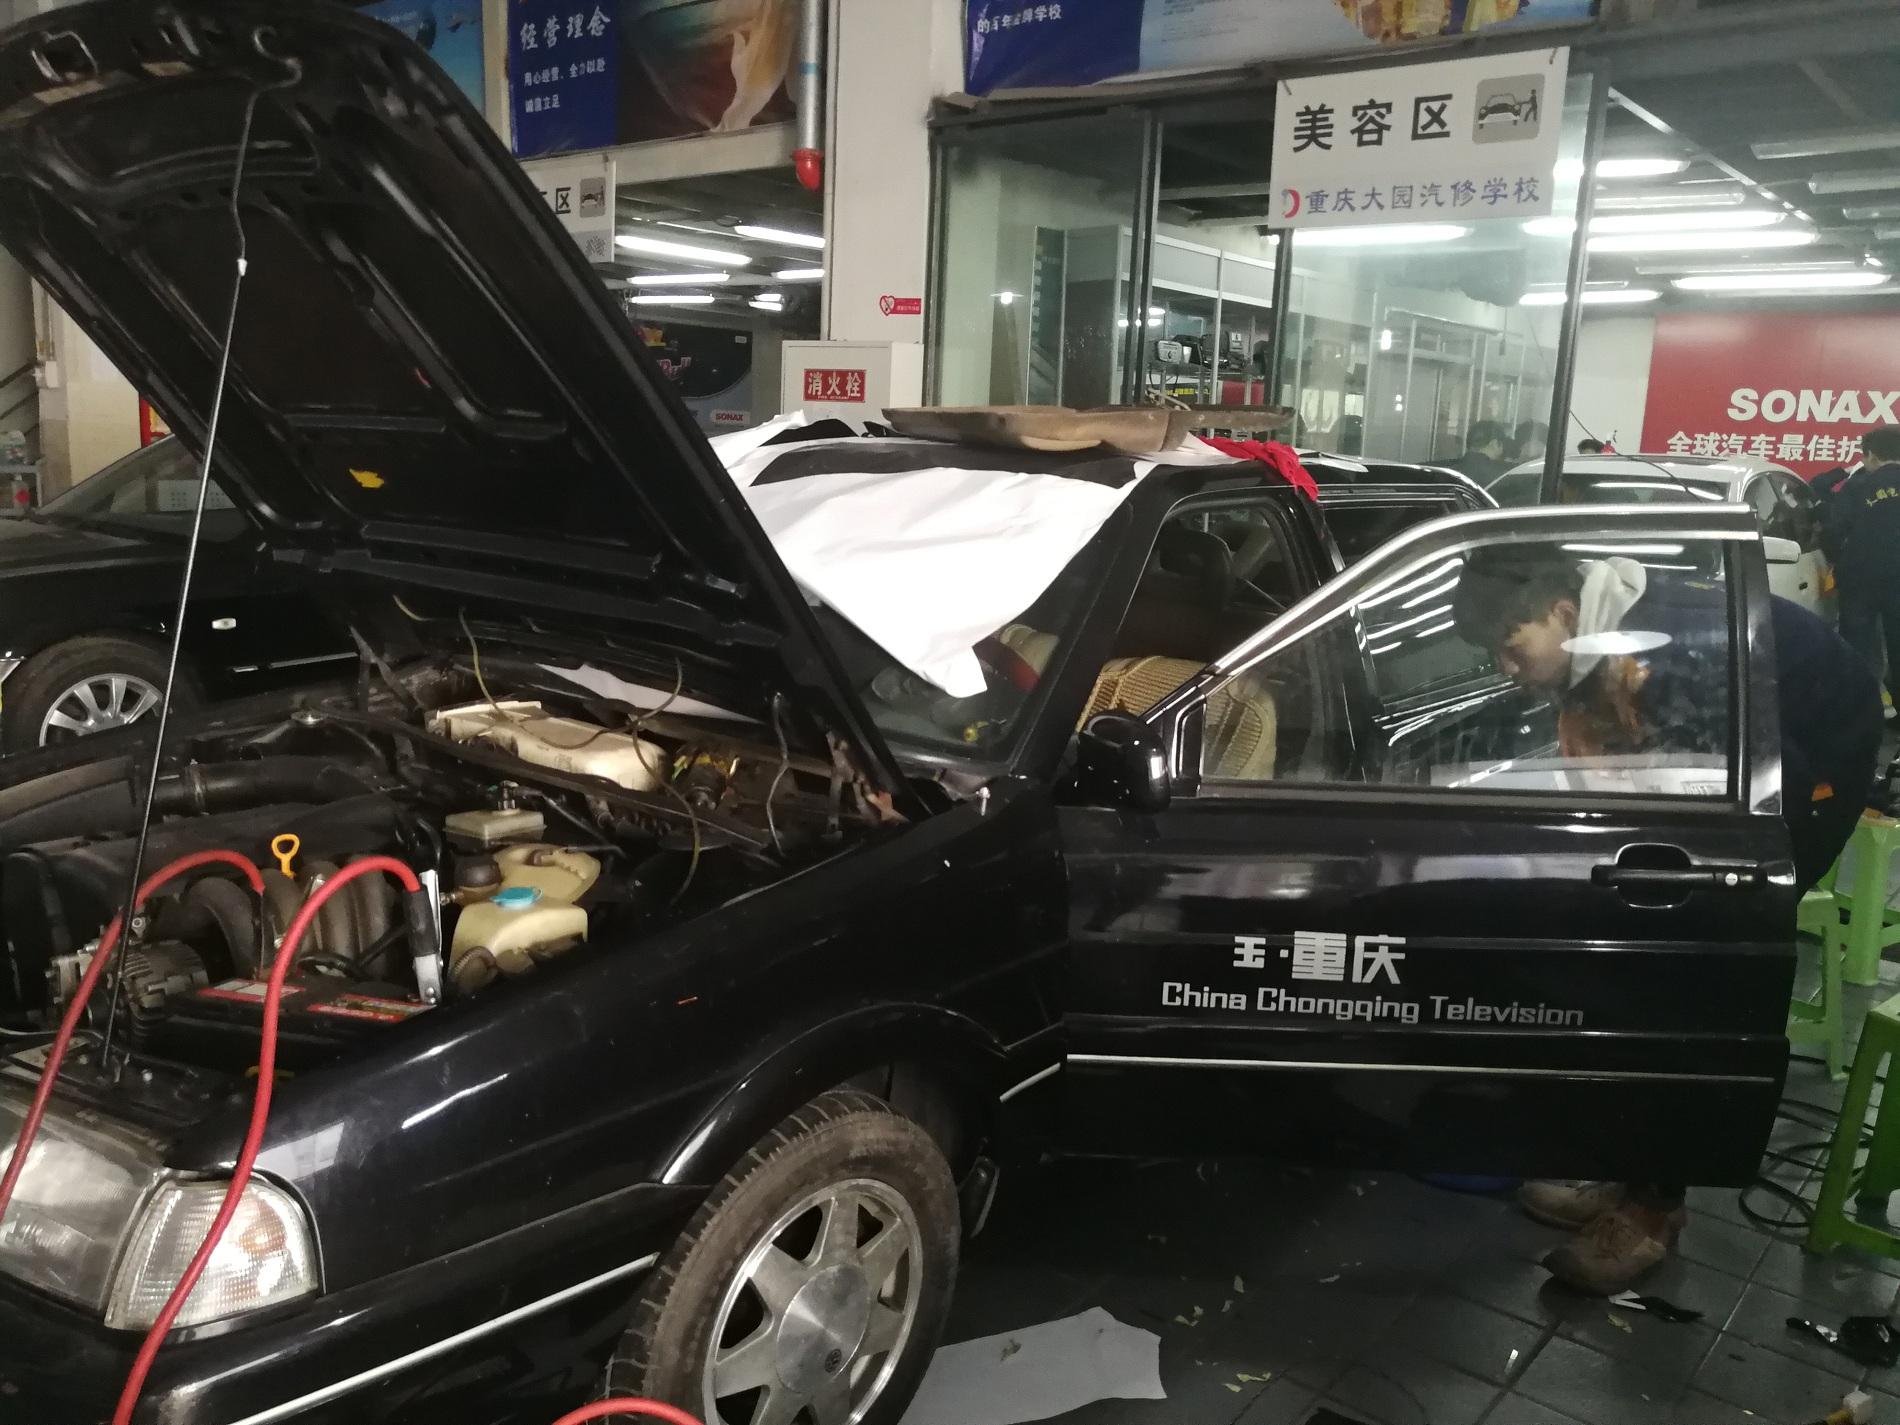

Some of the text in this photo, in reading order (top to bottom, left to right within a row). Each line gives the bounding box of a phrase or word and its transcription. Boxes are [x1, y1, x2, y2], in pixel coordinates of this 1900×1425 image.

[520, 6, 611, 50] 经营理念
[1292, 93, 1454, 153] 美容区
[1304, 176, 1541, 215] 重庆大园汽修学校
[807, 371, 862, 397] 消火栓
[1727, 387, 1900, 425] SONAX
[1161, 981, 1584, 1026] China Chongqing Television
